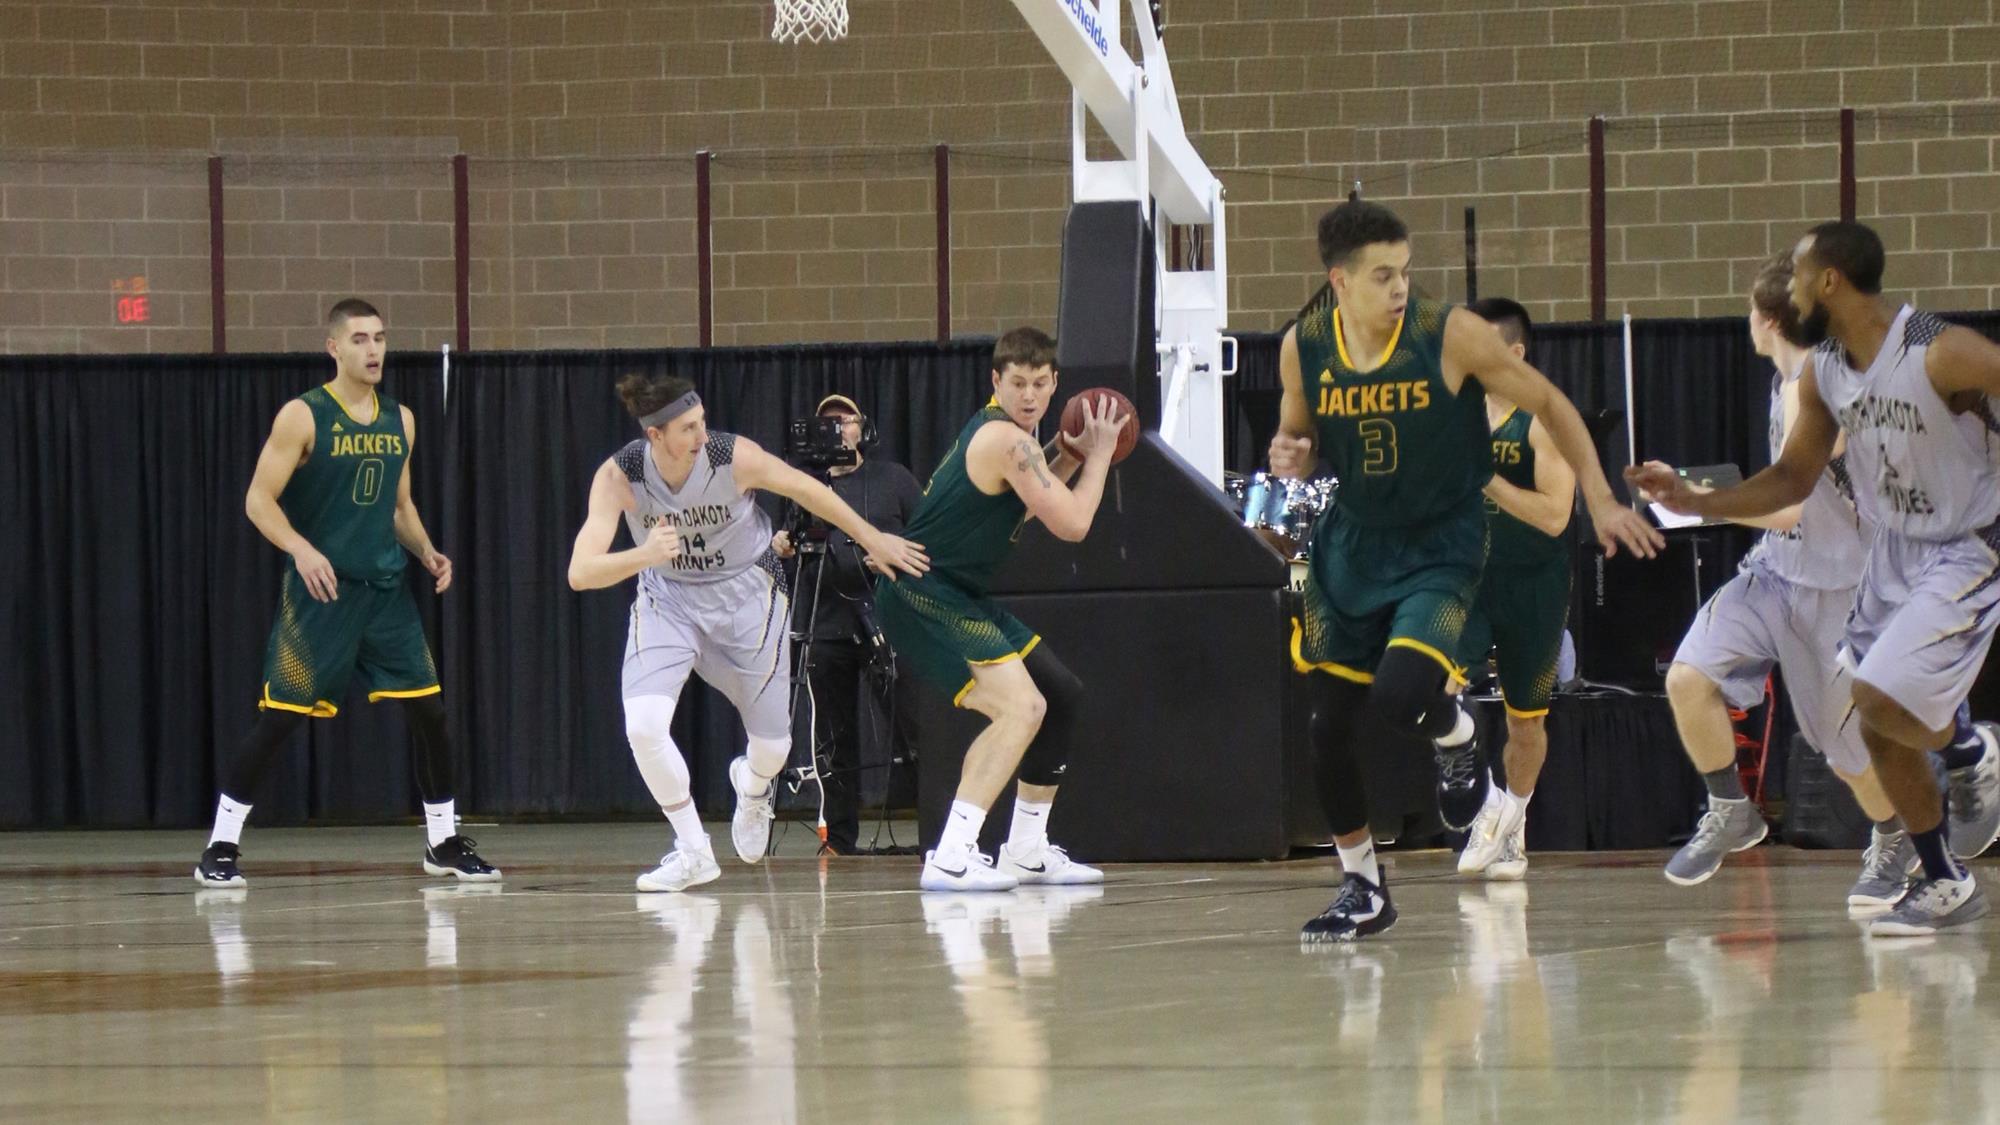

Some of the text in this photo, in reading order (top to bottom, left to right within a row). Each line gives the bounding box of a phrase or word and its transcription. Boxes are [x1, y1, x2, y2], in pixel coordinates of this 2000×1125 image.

[1065, 0, 1108, 57] chelde
[1317, 380, 1430, 416] JACKETS
[331, 433, 402, 456] JACKETS
[1359, 418, 1398, 474] 3
[353, 458, 384, 505] 0
[643, 505, 732, 529] SOTH DAKOTA
[680, 532, 706, 554] 14
